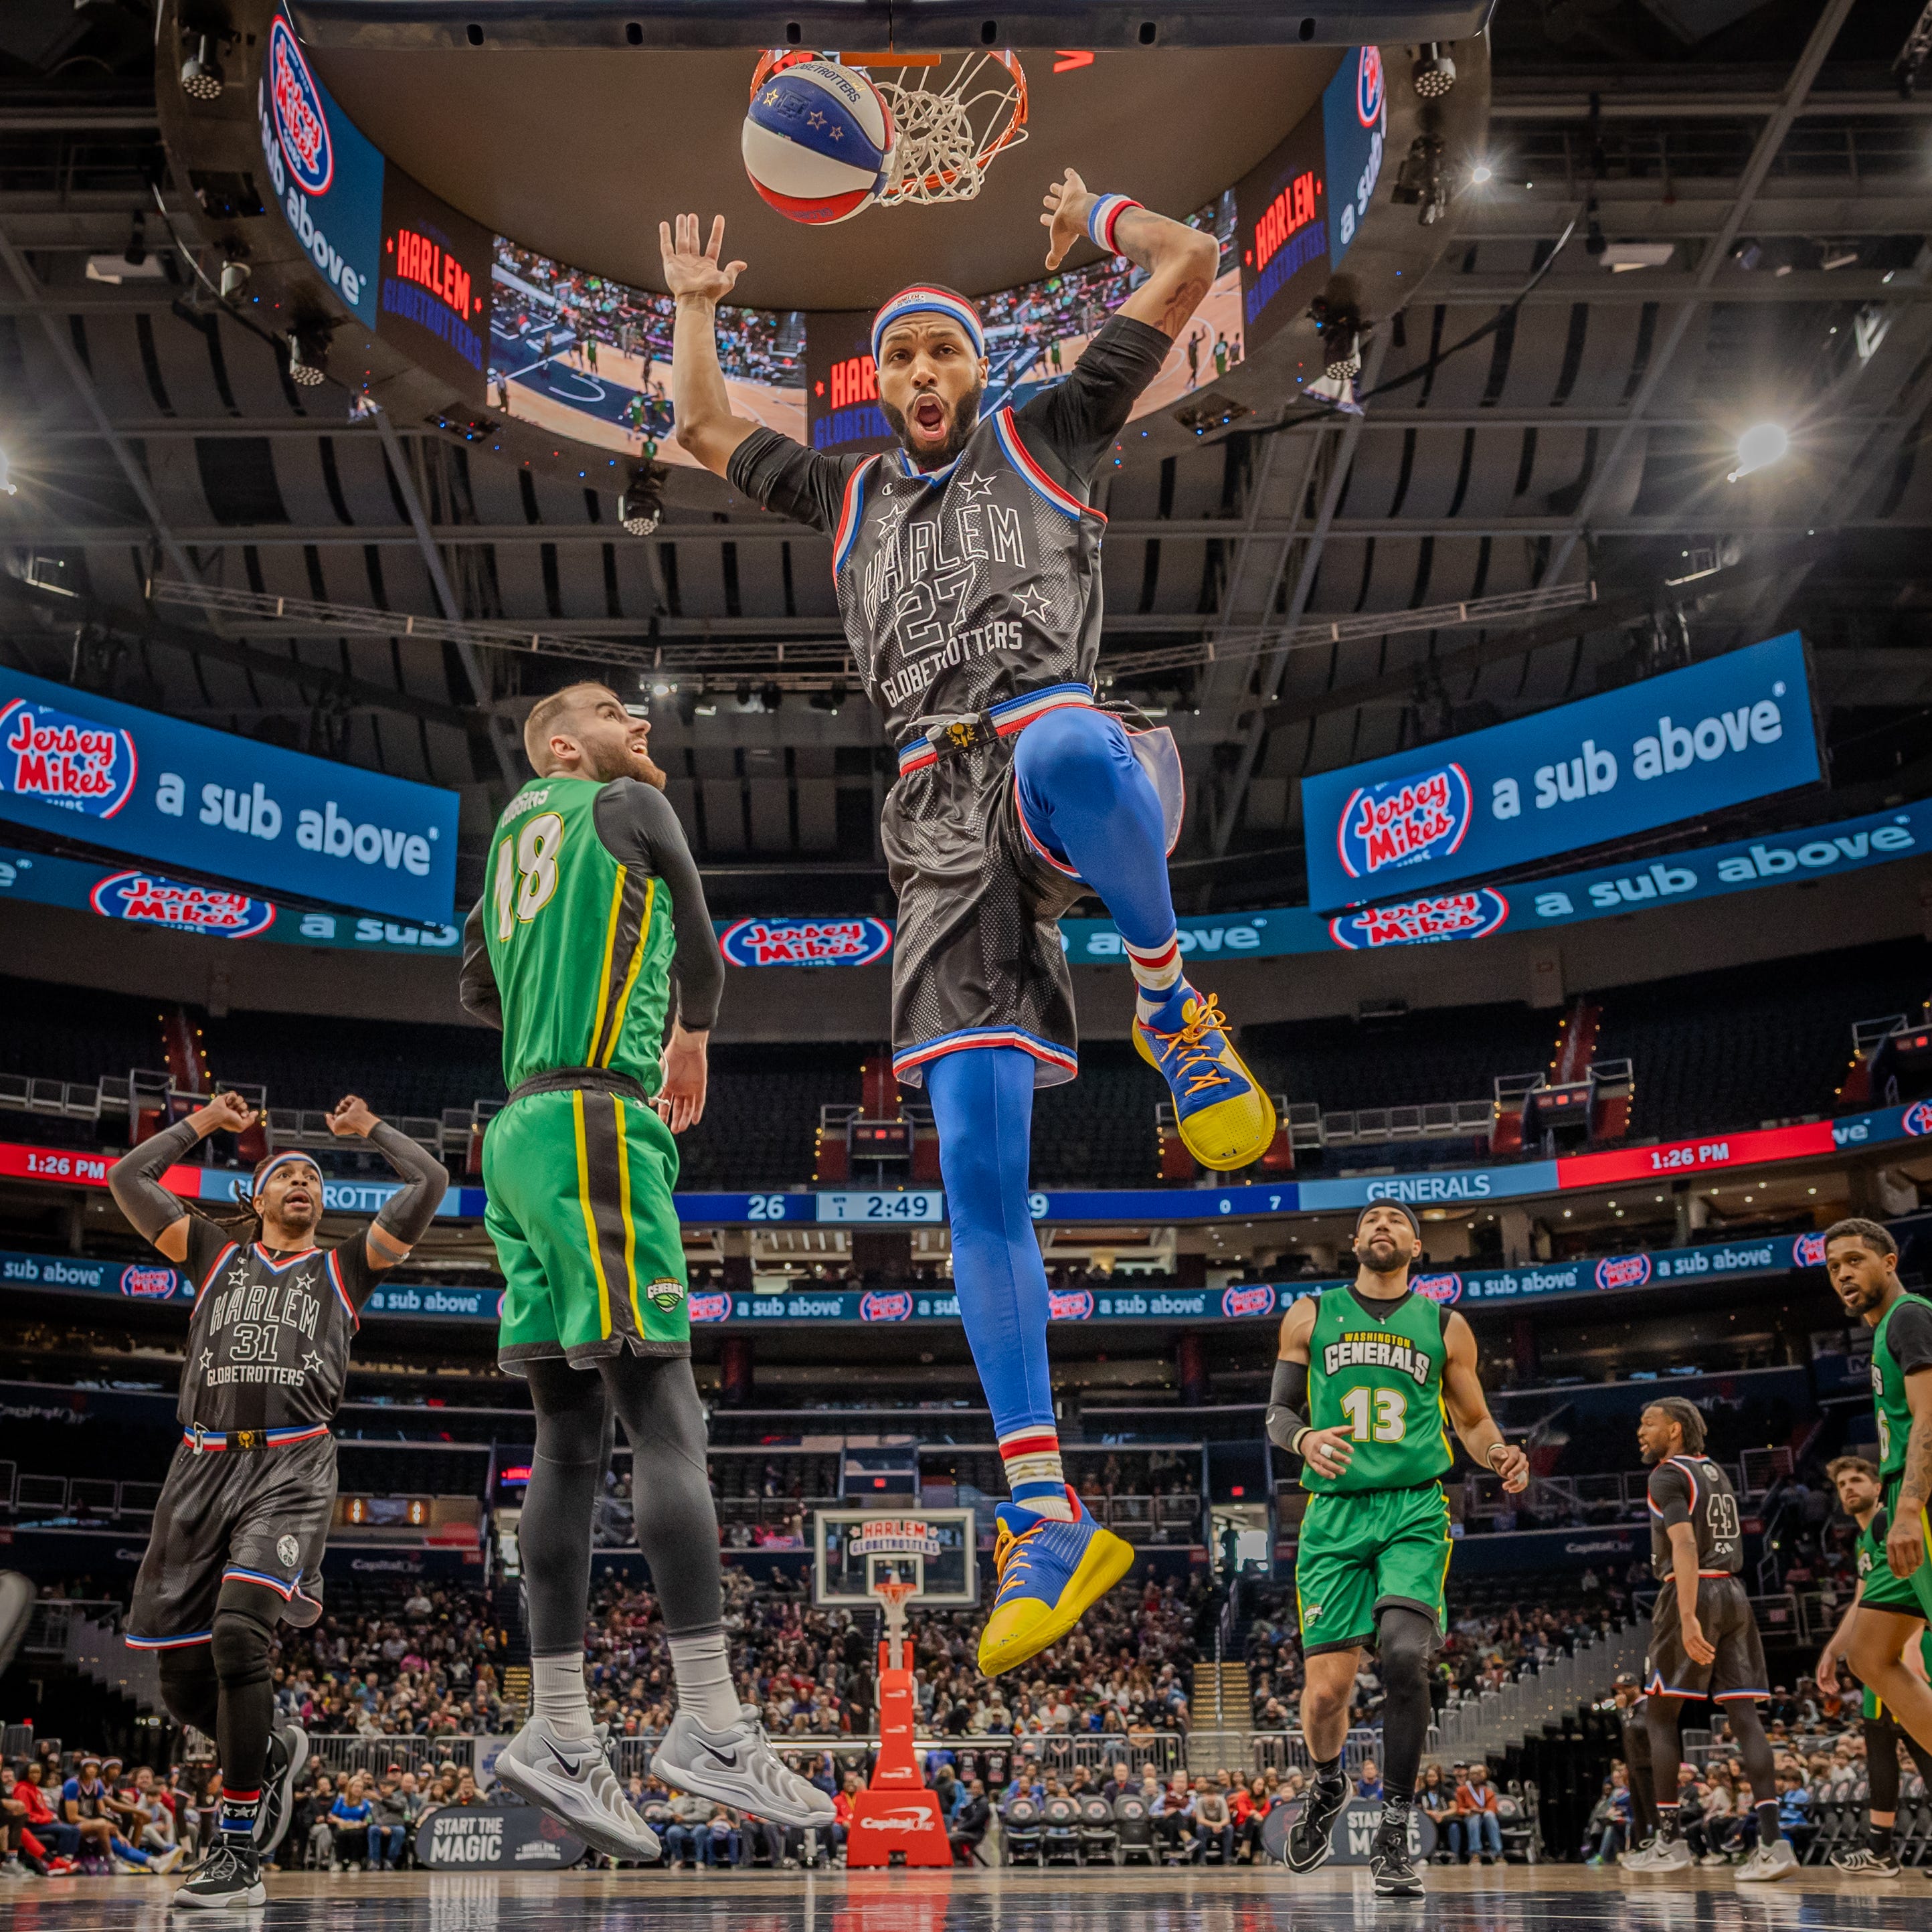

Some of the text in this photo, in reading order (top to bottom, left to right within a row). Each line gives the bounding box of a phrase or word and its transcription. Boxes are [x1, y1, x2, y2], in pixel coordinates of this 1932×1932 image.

[1255, 171, 1316, 272] HARLEM
[397, 228, 471, 321] HARLEM
[830, 355, 879, 410] HAR
[864, 503, 1027, 632] HARLEM
[894, 562, 976, 659] 27
[7, 713, 116, 769] Jersey
[15, 751, 116, 798] Mike's
[1491, 777, 1521, 820] a
[1533, 739, 1618, 809] sub
[155, 772, 185, 817] a
[199, 782, 282, 841] sub
[1354, 772, 1451, 839] Jersey
[1366, 810, 1456, 873] Mike's
[494, 811, 565, 943] 18
[1534, 891, 1574, 917] a
[1588, 863, 1698, 908] sub
[117, 879, 251, 912] Jersey
[1352, 892, 1482, 928] Jersey
[300, 913, 335, 939] a
[741, 921, 867, 946] Jersey
[1086, 926, 1261, 955] aove
[27, 1154, 105, 1180] 1:26 PM
[1651, 1142, 1730, 1170] 1:26 PM
[1270, 1195, 1281, 1211] 7
[1366, 1174, 1492, 1203] GENERALS
[748, 1194, 786, 1221] 26
[838, 1207, 844, 1218] 1
[867, 1196, 928, 1217] 2:49
[1219, 1199, 1231, 1215] 0
[4, 1258, 39, 1280] sub
[1658, 1260, 1671, 1277] a
[1674, 1252, 1709, 1275] sub
[371, 1292, 385, 1310] a
[388, 1289, 422, 1310] sub
[1468, 1280, 1480, 1296] a
[1484, 1274, 1517, 1296] sub
[209, 1285, 321, 1340] HARLEM
[737, 1300, 750, 1316] a
[752, 1296, 784, 1316] sub
[917, 1299, 931, 1316] a
[1098, 1299, 1112, 1314] a
[1115, 1294, 1147, 1314] sub
[1280, 1292, 1293, 1308] a
[229, 1323, 279, 1362] 31
[1344, 1332, 1411, 1349] WASHINGTON
[206, 1365, 305, 1387] GLOBETROTTERS
[1324, 1341, 1431, 1386] GENERALS
[1340, 1385, 1408, 1443] 13
[863, 1520, 927, 1537] HARLEM
[434, 1817, 504, 1836] START THE
[429, 1834, 503, 1863] MAGIC
